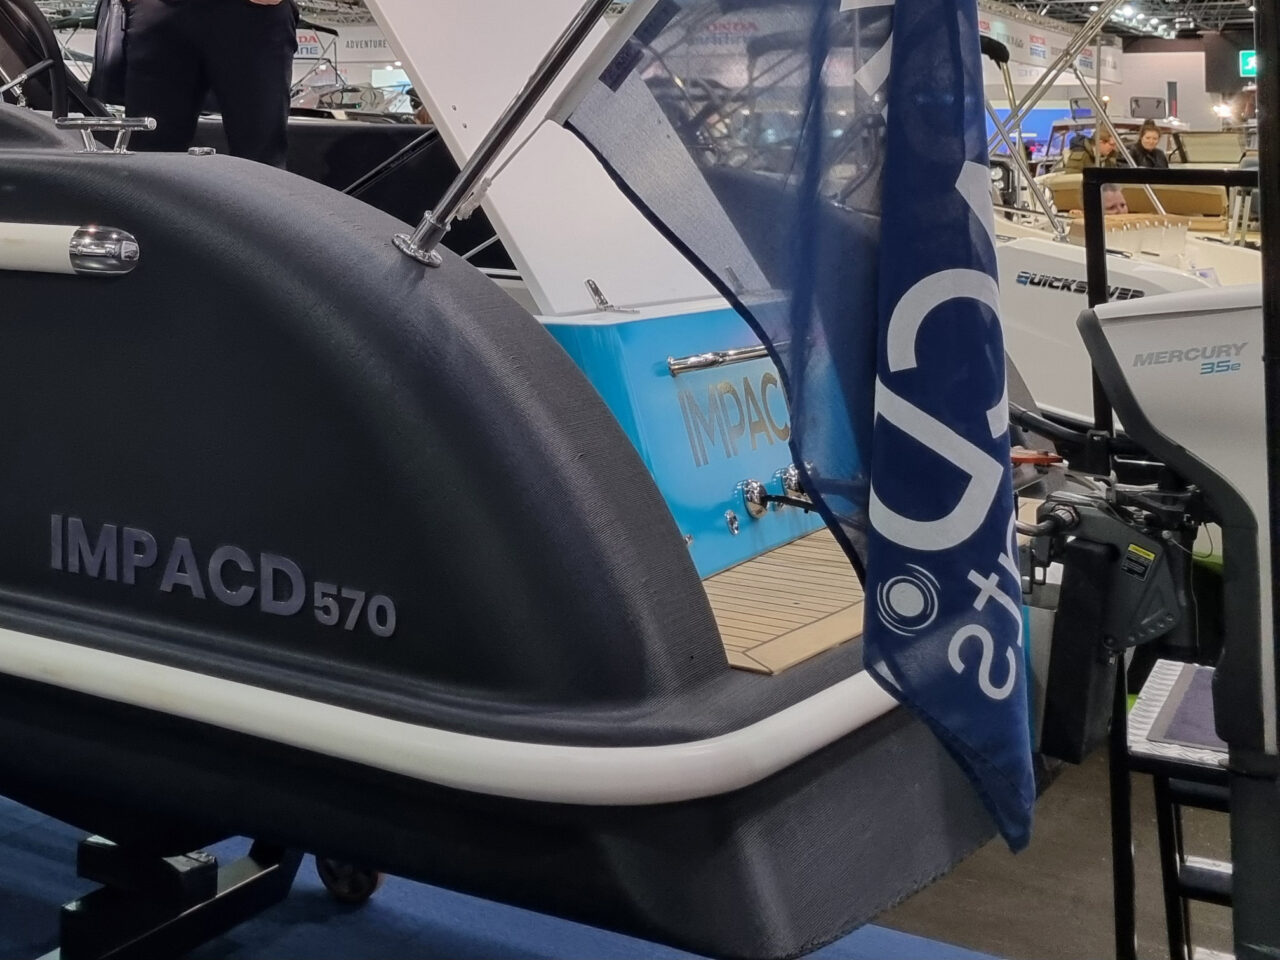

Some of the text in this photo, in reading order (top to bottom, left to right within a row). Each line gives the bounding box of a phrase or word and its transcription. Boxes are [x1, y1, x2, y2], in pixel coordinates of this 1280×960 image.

[345, 39, 387, 49] ADVENTURE
[1017, 271, 1145, 300] QUICKSVER
[1133, 342, 1248, 367] MERCURY
[1200, 359, 1241, 375] 35e
[678, 371, 790, 468] IMPAC
[50, 514, 397, 638] IMPACD 570
